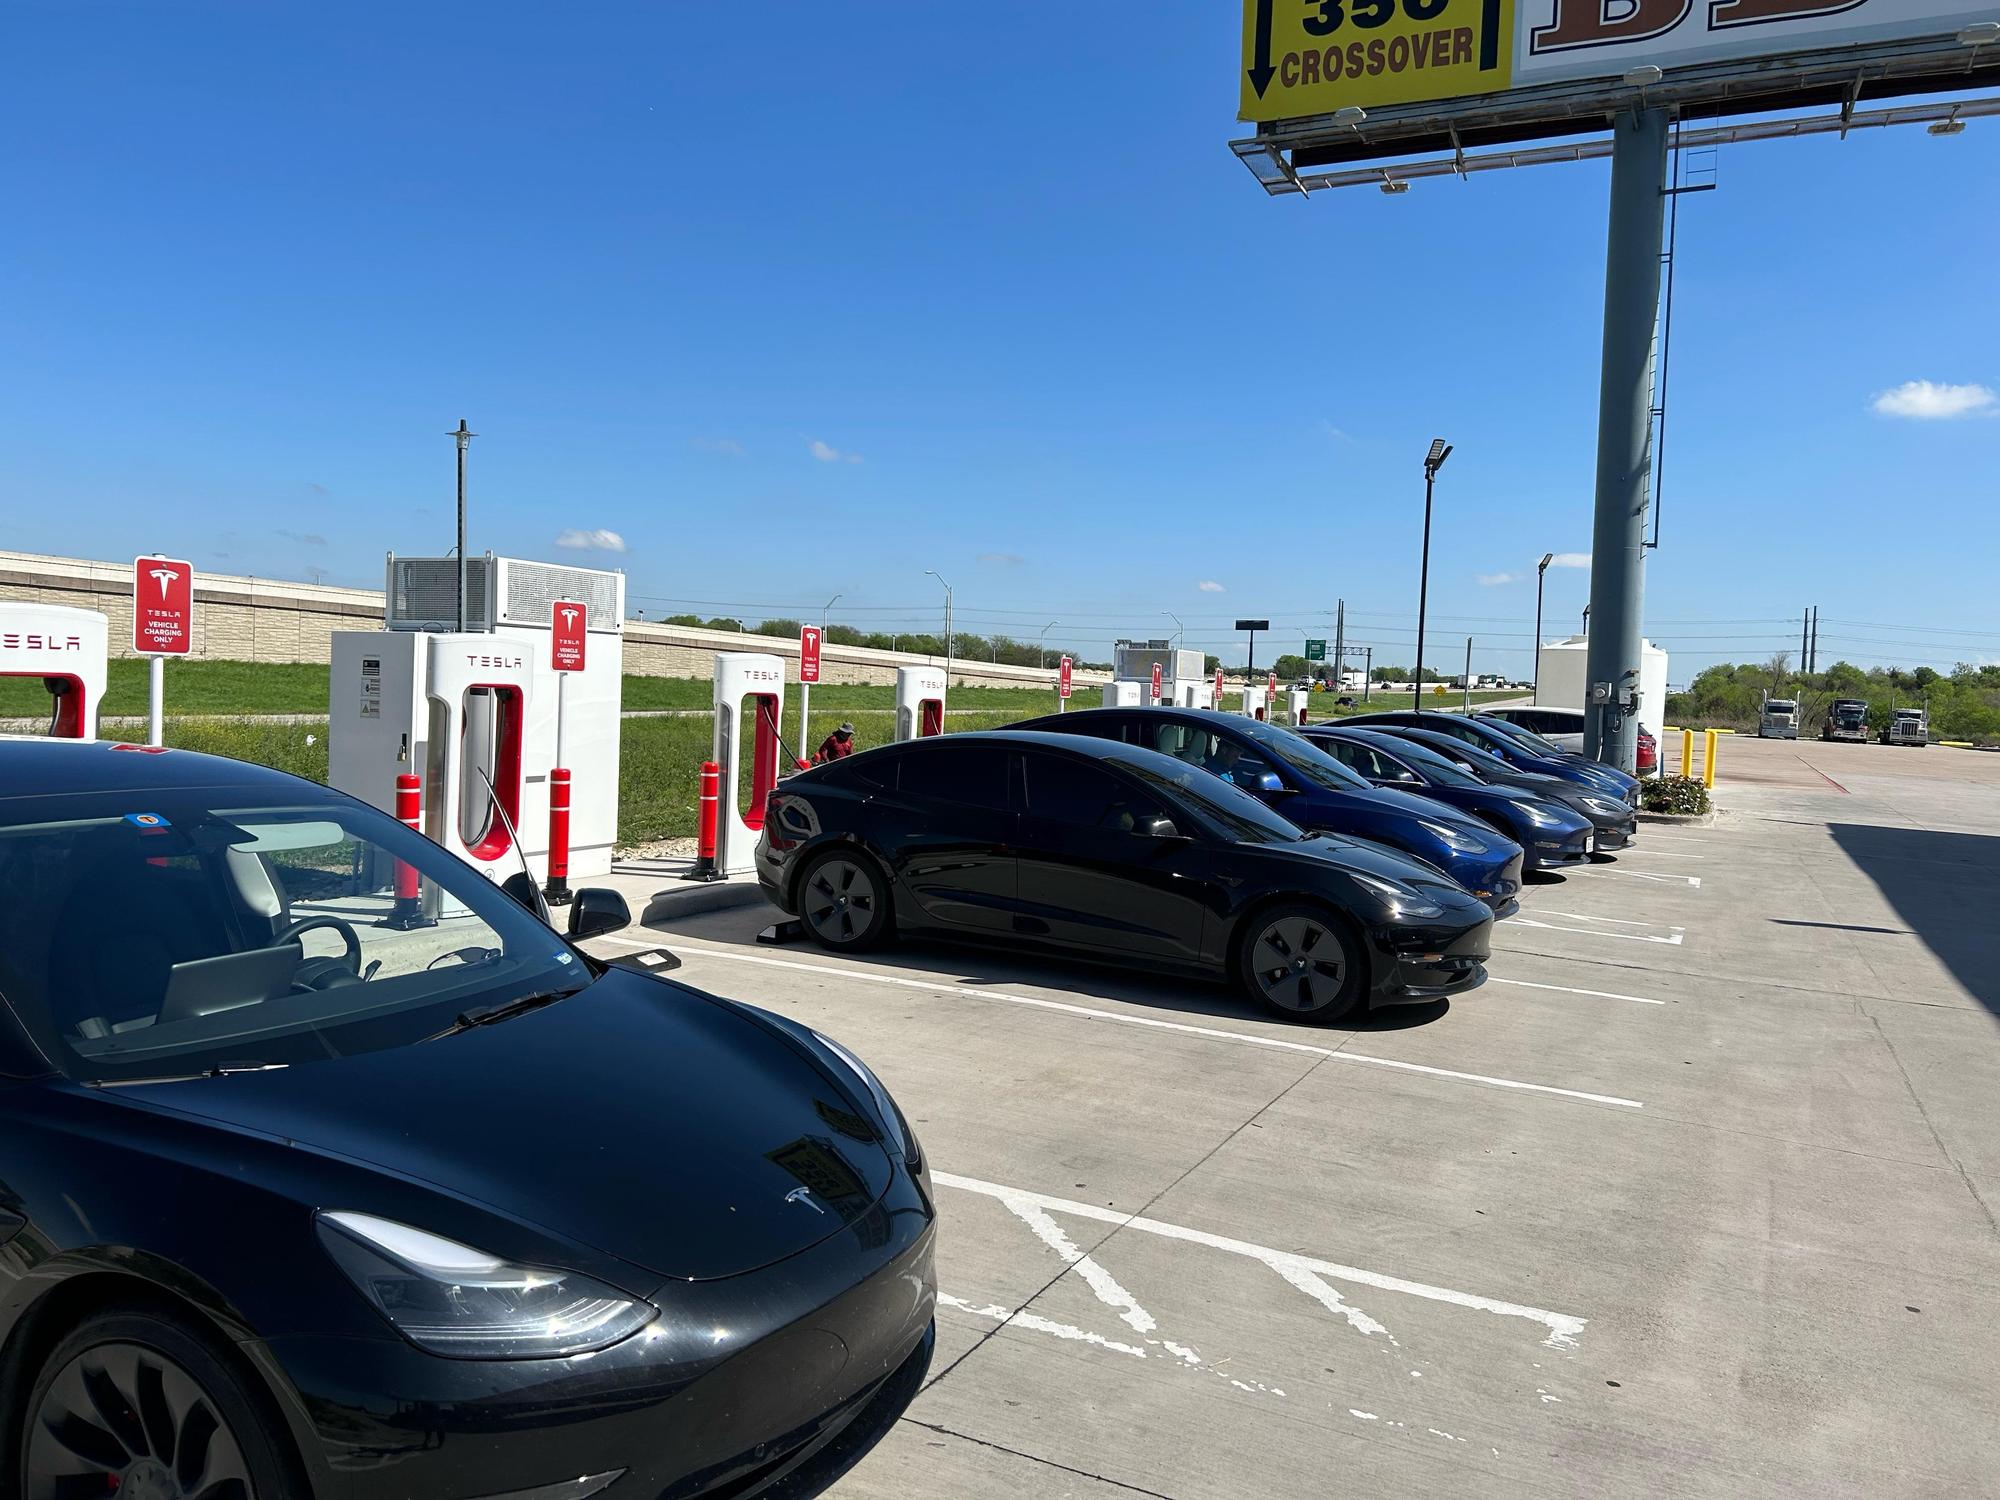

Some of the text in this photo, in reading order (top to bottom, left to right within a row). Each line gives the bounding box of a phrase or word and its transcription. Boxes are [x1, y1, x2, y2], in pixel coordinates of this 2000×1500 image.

[1280, 27, 1473, 88] CROSSOVER
[147, 609, 181, 618] TESLA
[148, 621, 179, 629] VEHICLE
[144, 628, 183, 637] CHARGING
[3, 634, 80, 650] ESLA
[466, 655, 522, 669] TESLA
[743, 670, 779, 681] TESLA
[920, 680, 944, 689] TESLA
